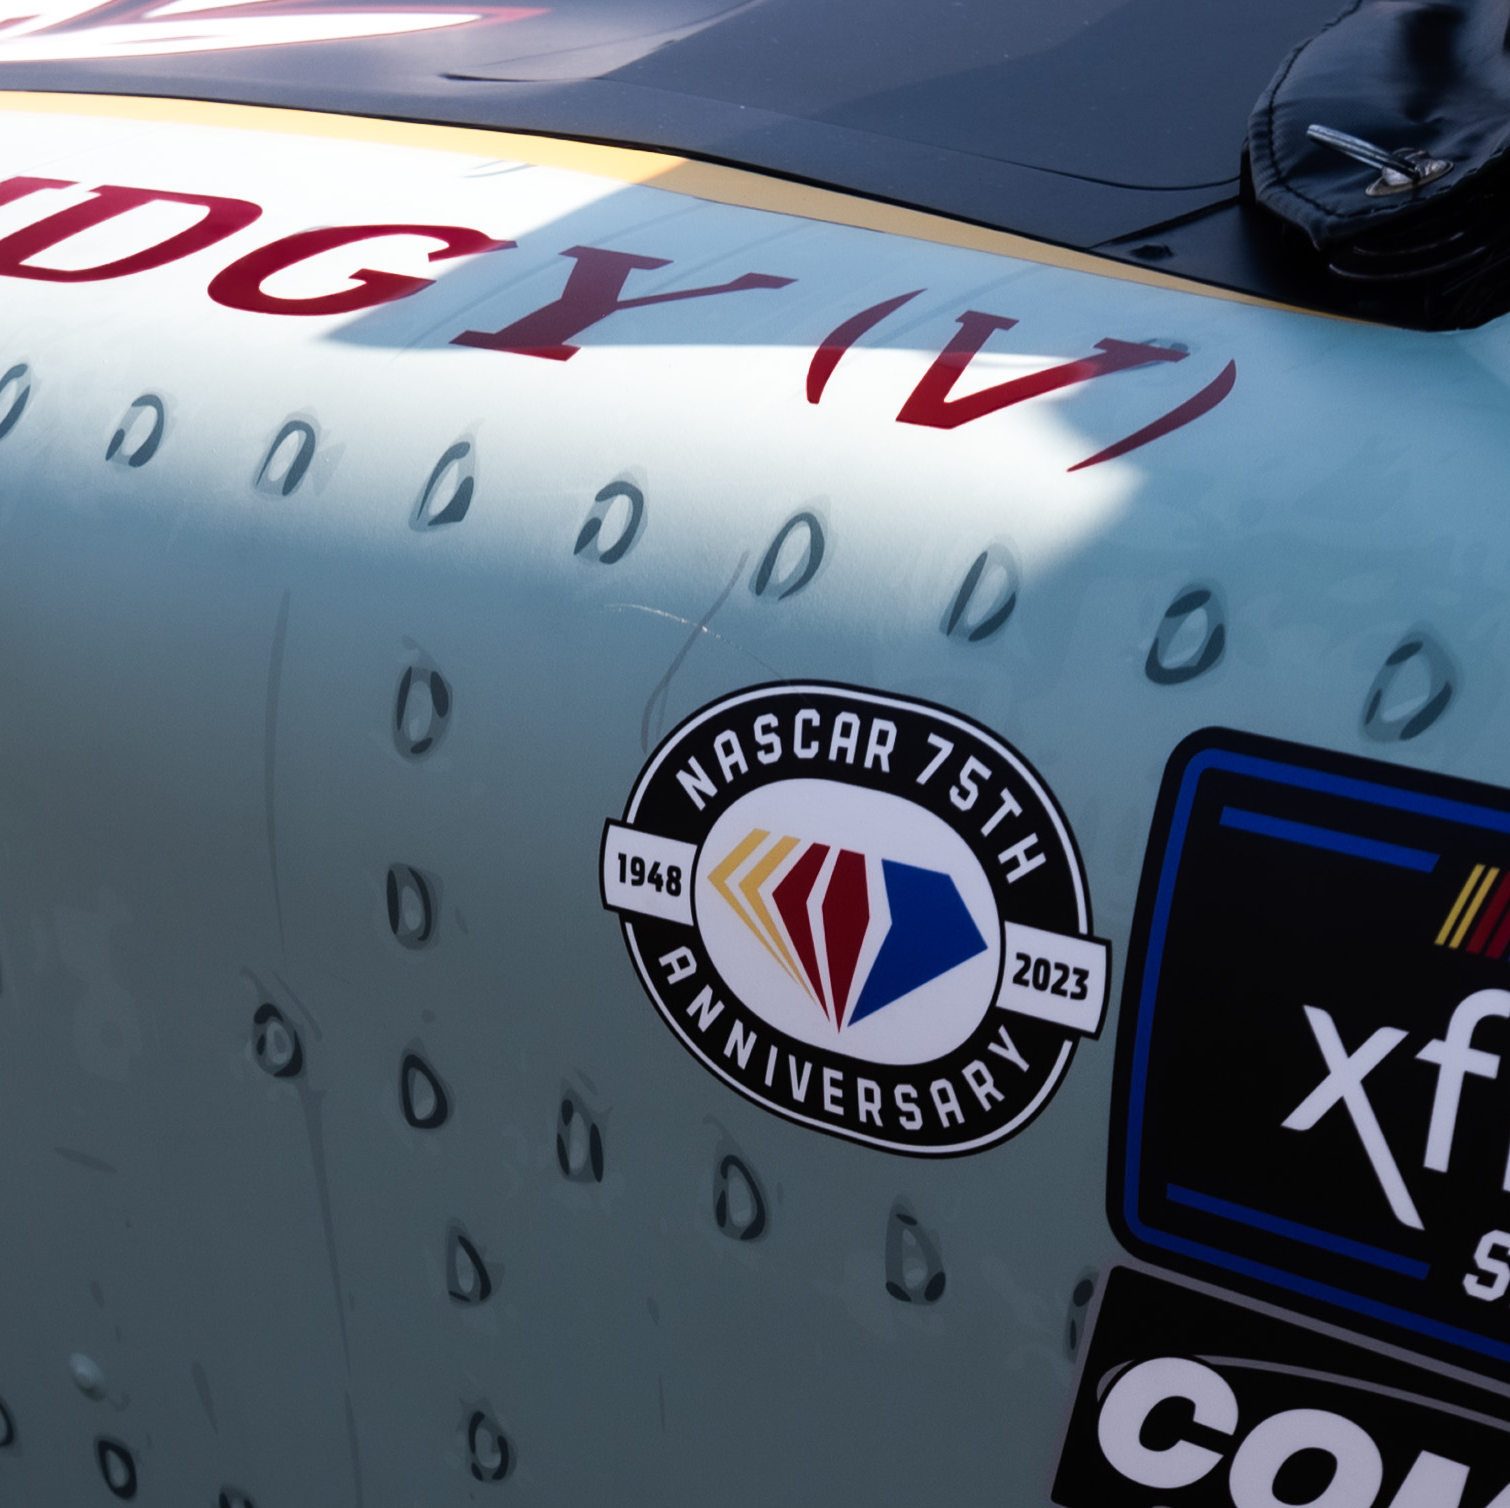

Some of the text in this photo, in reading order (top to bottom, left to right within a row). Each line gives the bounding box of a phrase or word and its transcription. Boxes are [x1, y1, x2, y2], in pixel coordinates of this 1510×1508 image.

[806, 288, 1237, 472] (V)
[617, 852, 683, 898] 1948
[675, 708, 1047, 885] NASCAR 75TH
[658, 945, 1031, 1131] ANNIVERSARY
[1012, 952, 1090, 1002] 2023
